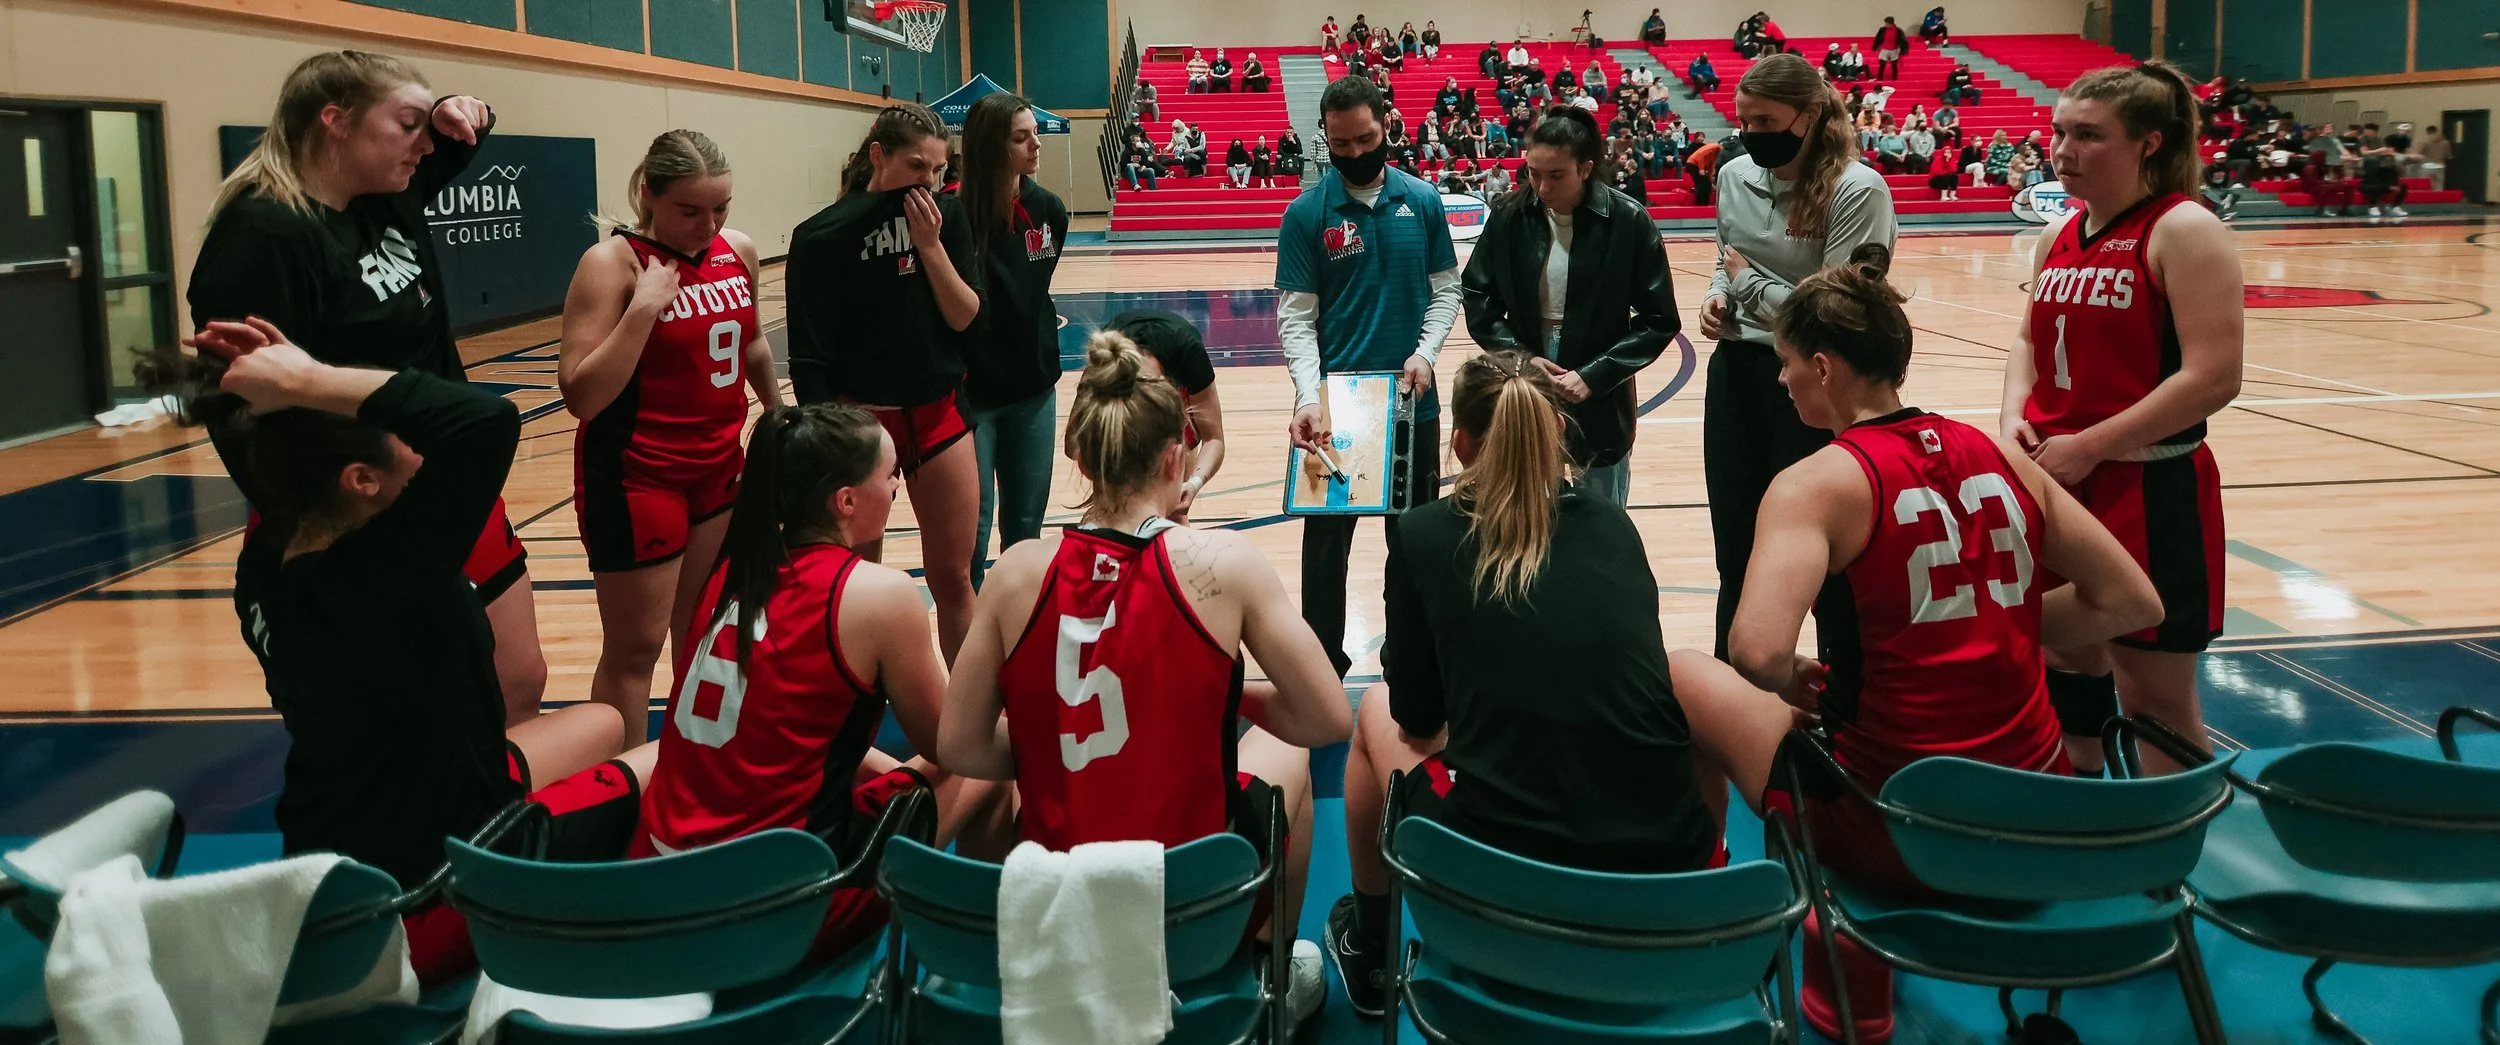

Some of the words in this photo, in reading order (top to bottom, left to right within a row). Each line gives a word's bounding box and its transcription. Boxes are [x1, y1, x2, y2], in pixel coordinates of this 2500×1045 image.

[446, 222, 522, 246] COLLEGE
[708, 319, 742, 389] 9
[2054, 314, 2072, 391] 1
[1893, 472, 2035, 624] 23
[673, 598, 768, 749] 6
[1055, 599, 1130, 773] 5
